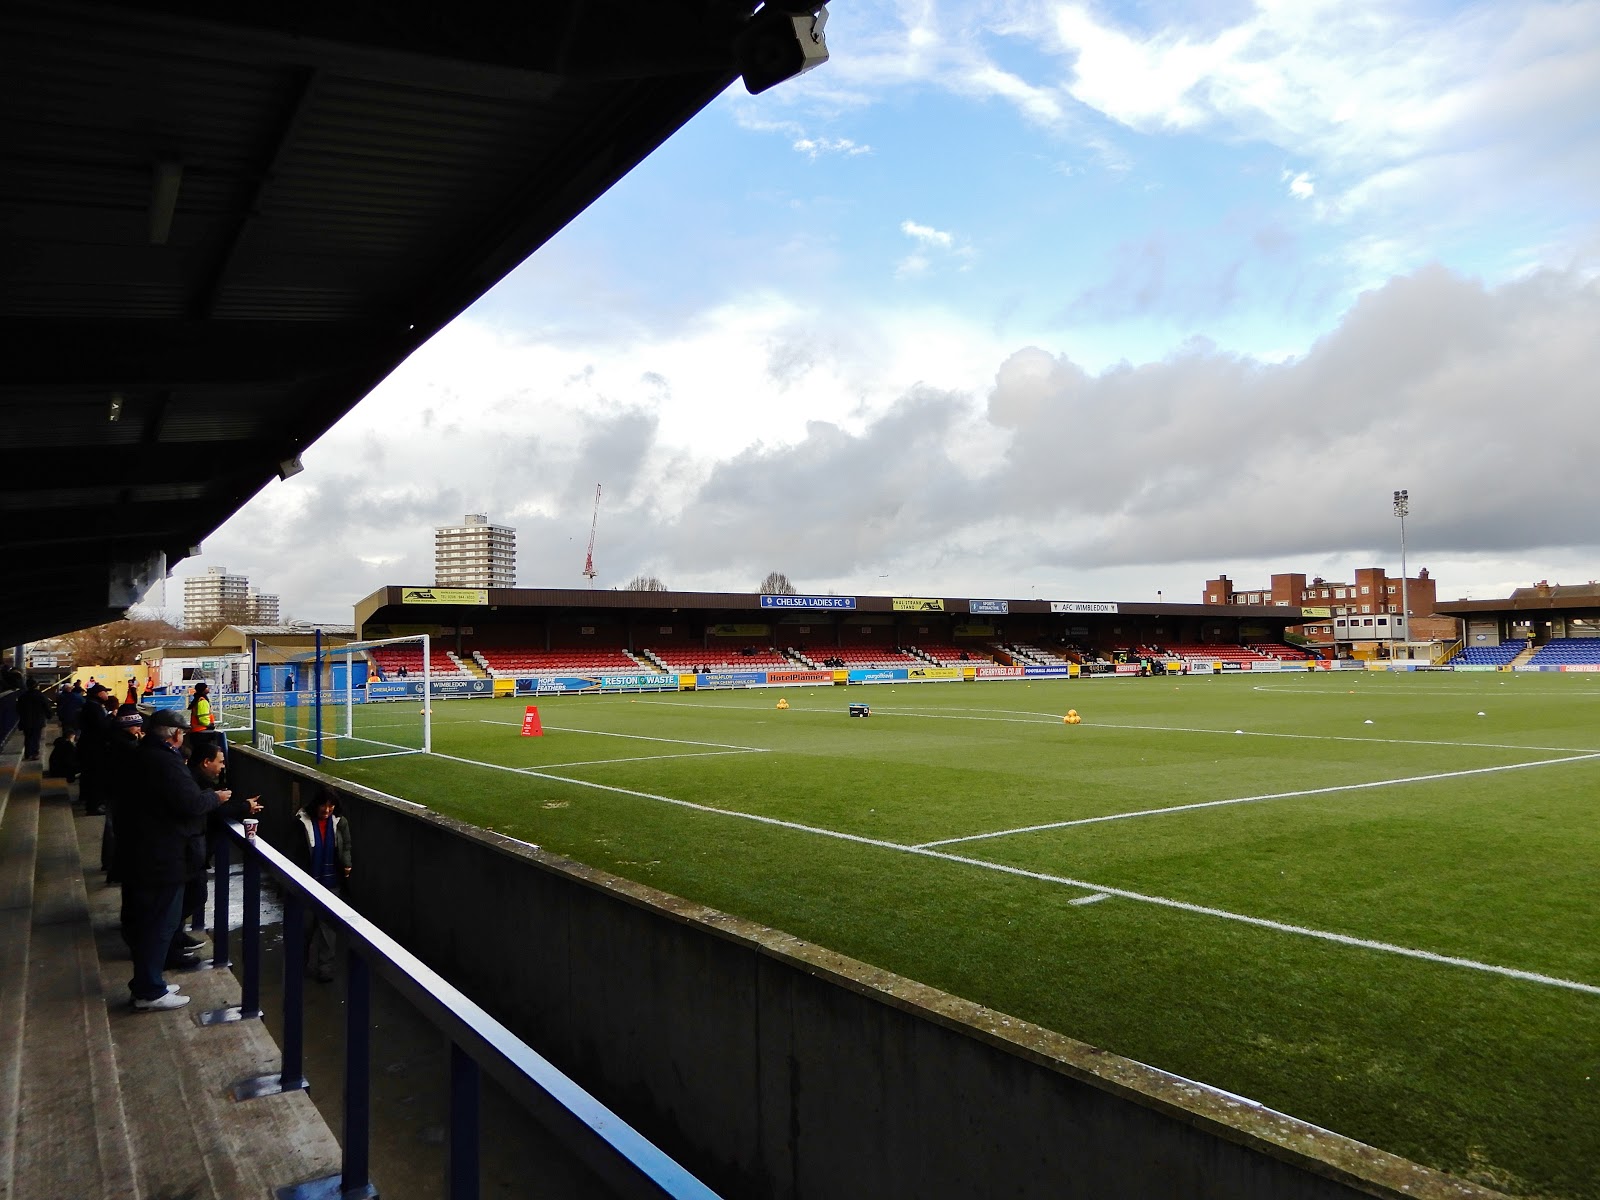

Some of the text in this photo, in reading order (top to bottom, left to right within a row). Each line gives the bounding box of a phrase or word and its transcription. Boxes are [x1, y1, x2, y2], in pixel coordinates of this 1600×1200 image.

[776, 598, 843, 607] CHELSEA LADIES FC
[1075, 604, 1109, 612] WIMBLEDON
[979, 667, 1022, 676] CHERRYRED.CO.UK
[605, 676, 674, 685] RESTON WASTE
